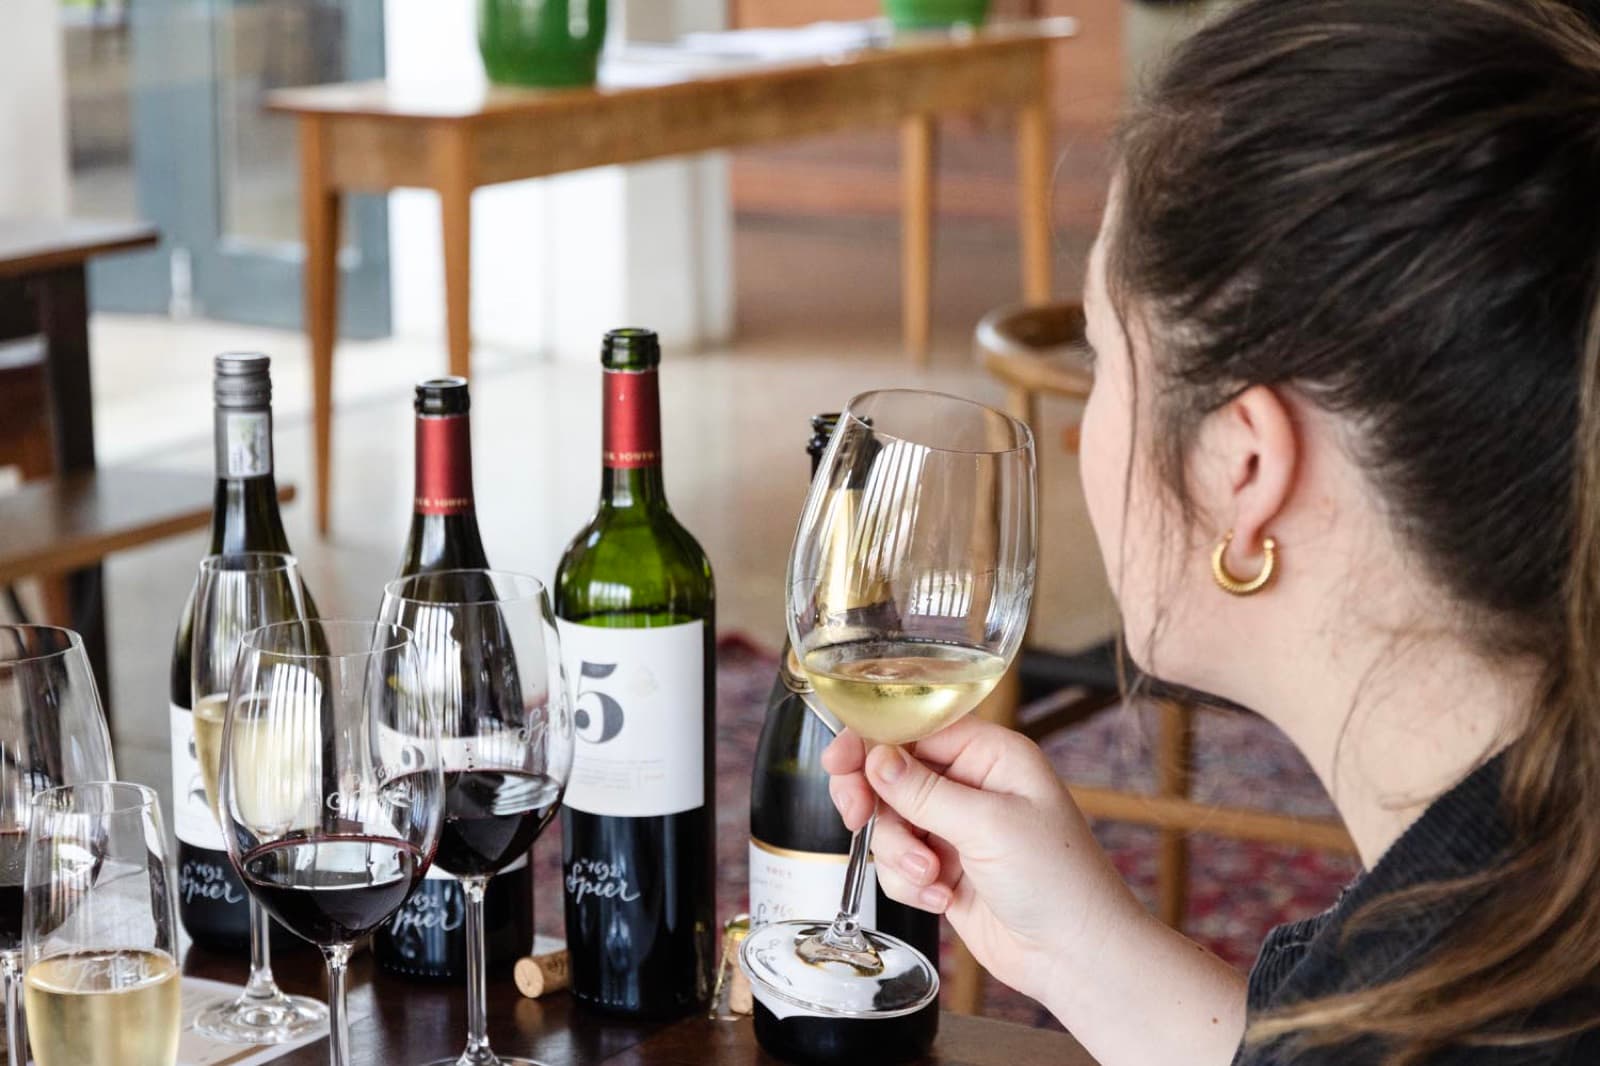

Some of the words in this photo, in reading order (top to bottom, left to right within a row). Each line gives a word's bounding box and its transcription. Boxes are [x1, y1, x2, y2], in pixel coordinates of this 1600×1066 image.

[574, 661, 625, 744] 5
[565, 861, 641, 905] Spier
[391, 908, 463, 935] pier
